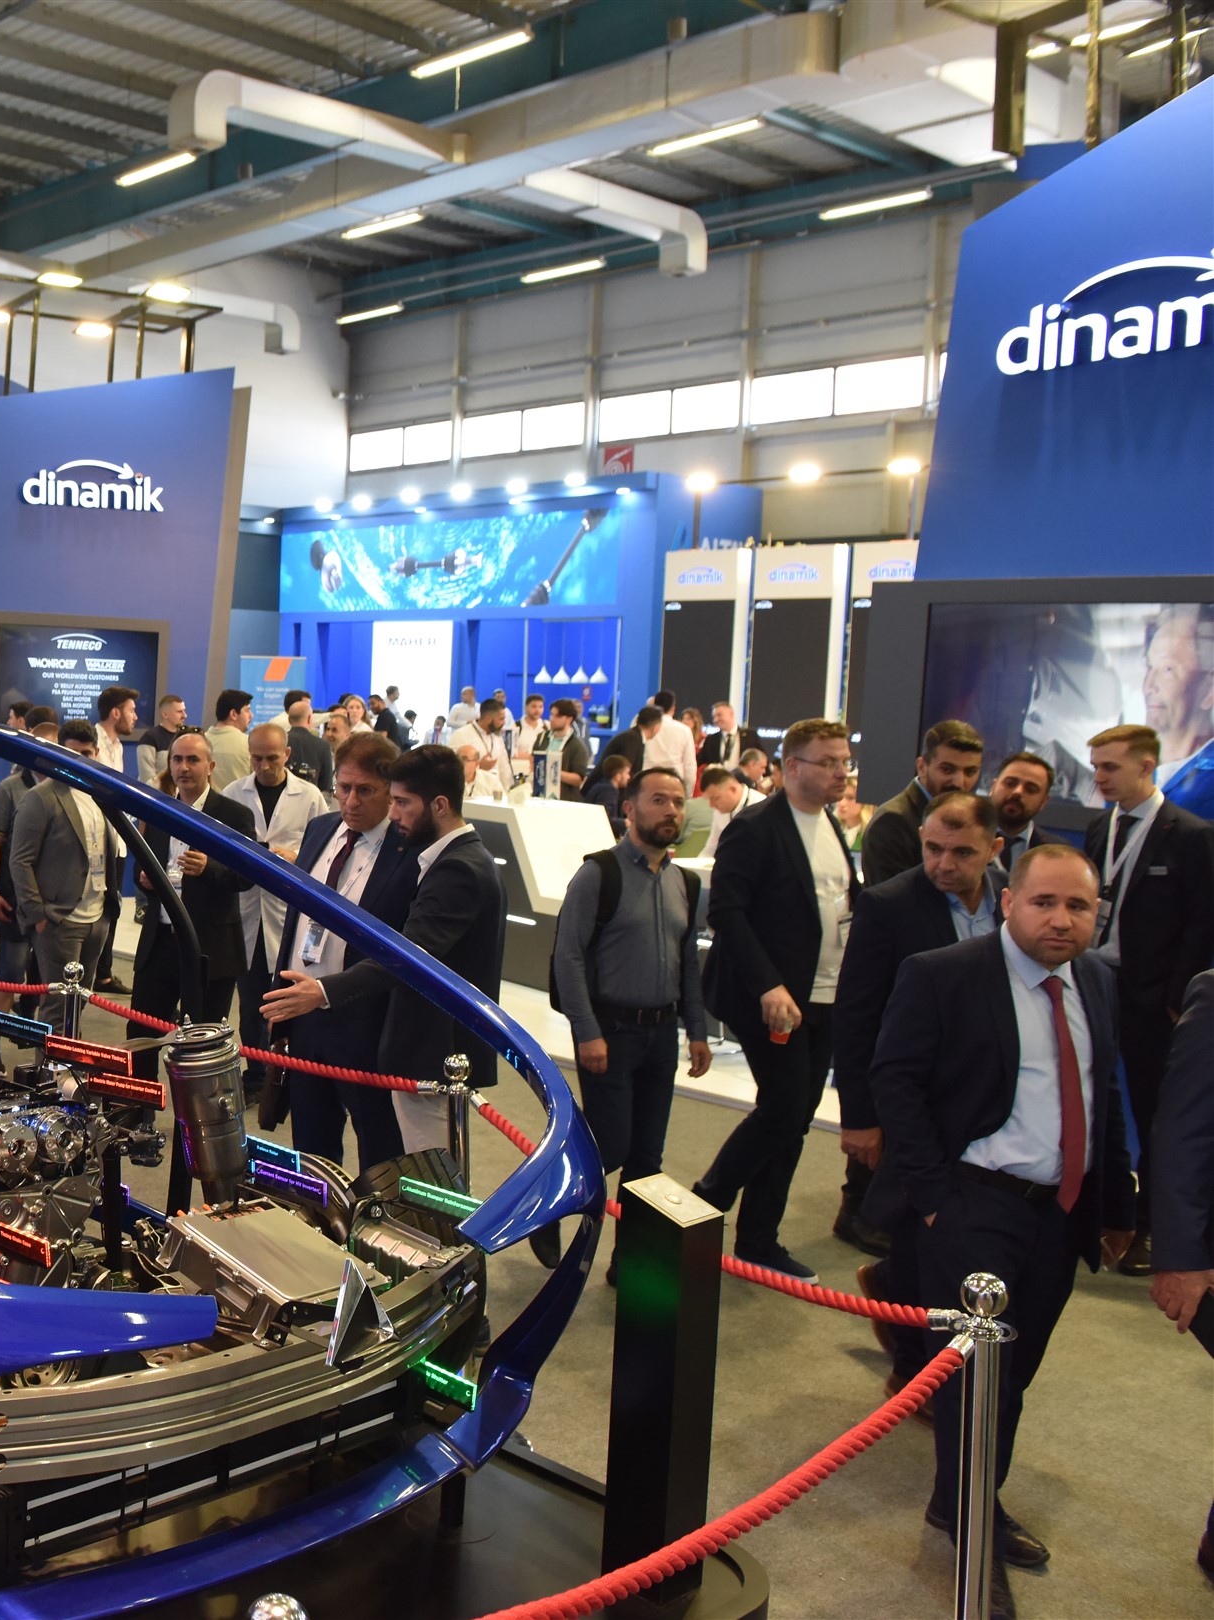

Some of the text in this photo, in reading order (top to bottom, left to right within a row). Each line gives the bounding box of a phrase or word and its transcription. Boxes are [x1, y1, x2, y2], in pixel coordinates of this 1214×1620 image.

[22, 468, 164, 512] dinamik
[677, 569, 724, 585] dinamik
[769, 566, 819, 582] dinamik
[56, 639, 103, 651] TENNECO
[29, 658, 126, 672] MONROE WALKER
[55, 672, 88, 680] WORLDWIDE
[88, 674, 119, 682] CUSTOMERS
